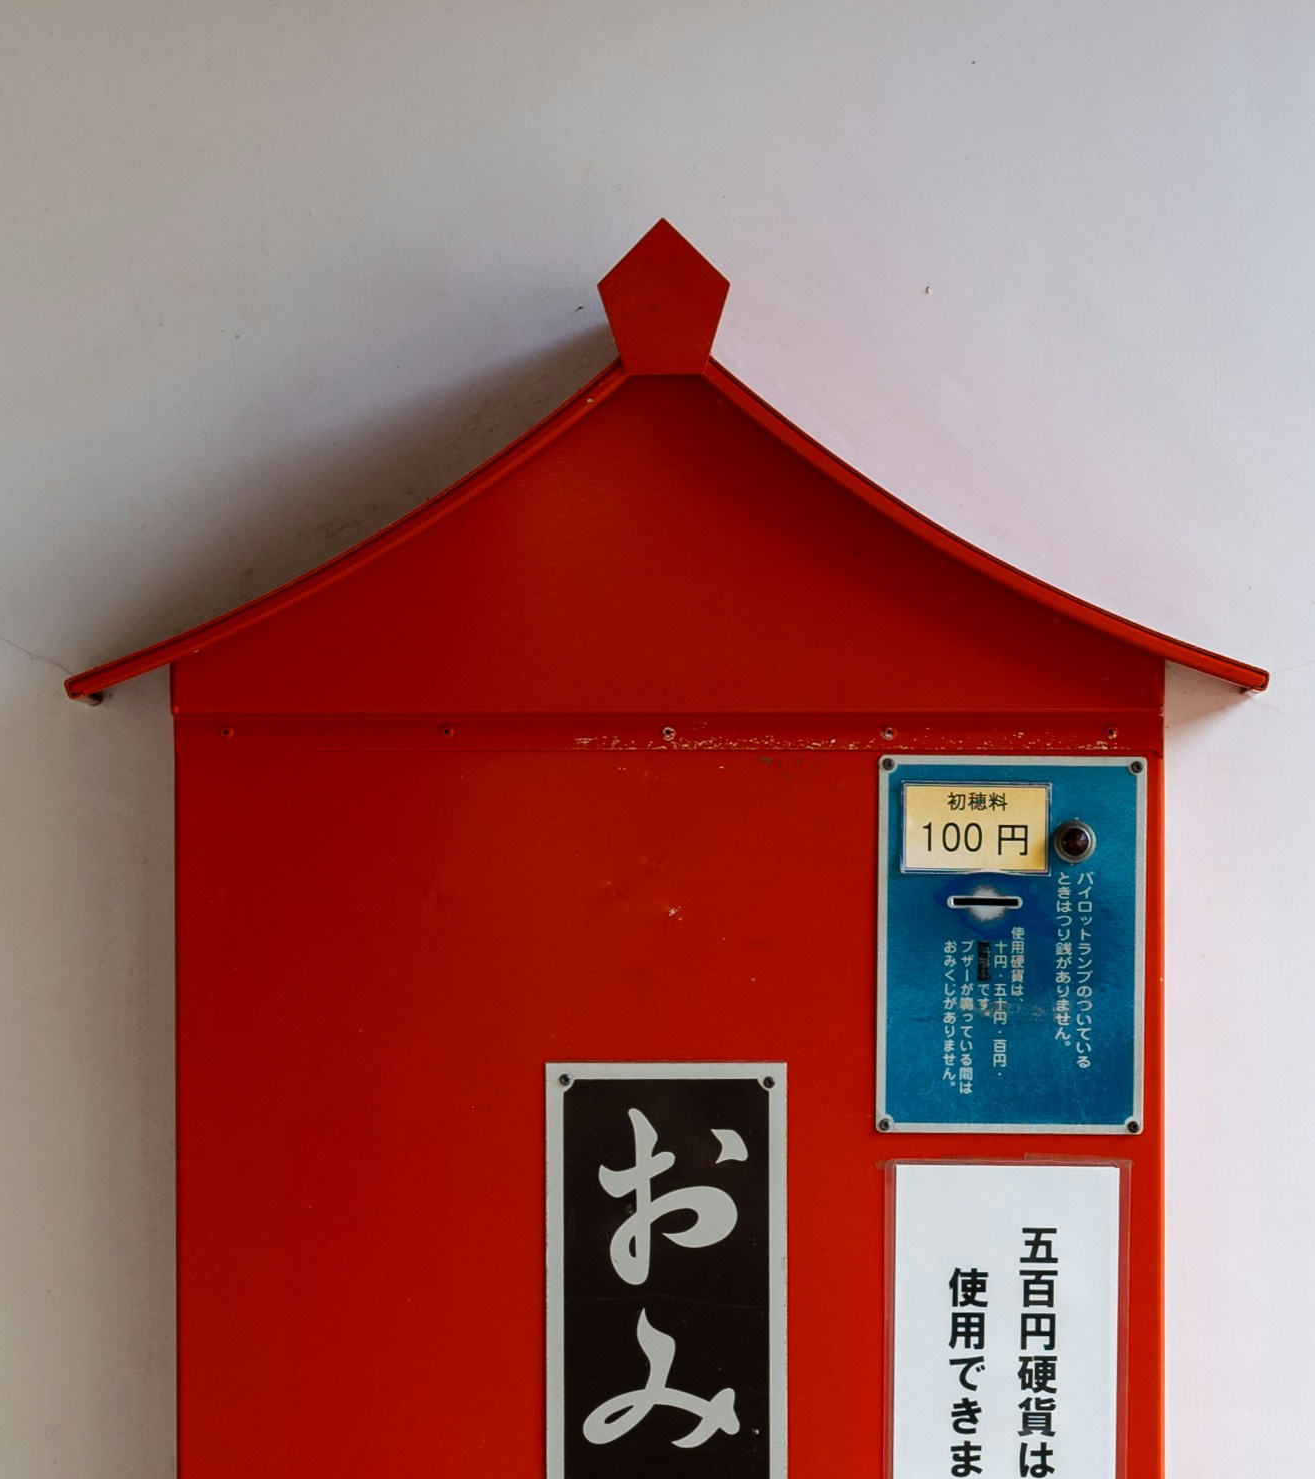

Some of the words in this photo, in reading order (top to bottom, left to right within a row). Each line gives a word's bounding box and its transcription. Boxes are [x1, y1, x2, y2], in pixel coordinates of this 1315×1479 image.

[947, 791, 1008, 811] 初穂料
[1010, 926, 1025, 1002] 使用硬貨は、
[1052, 871, 1073, 1047] ときはつり銭がありません。
[1017, 1227, 1059, 1479] 五百円硬貨は
